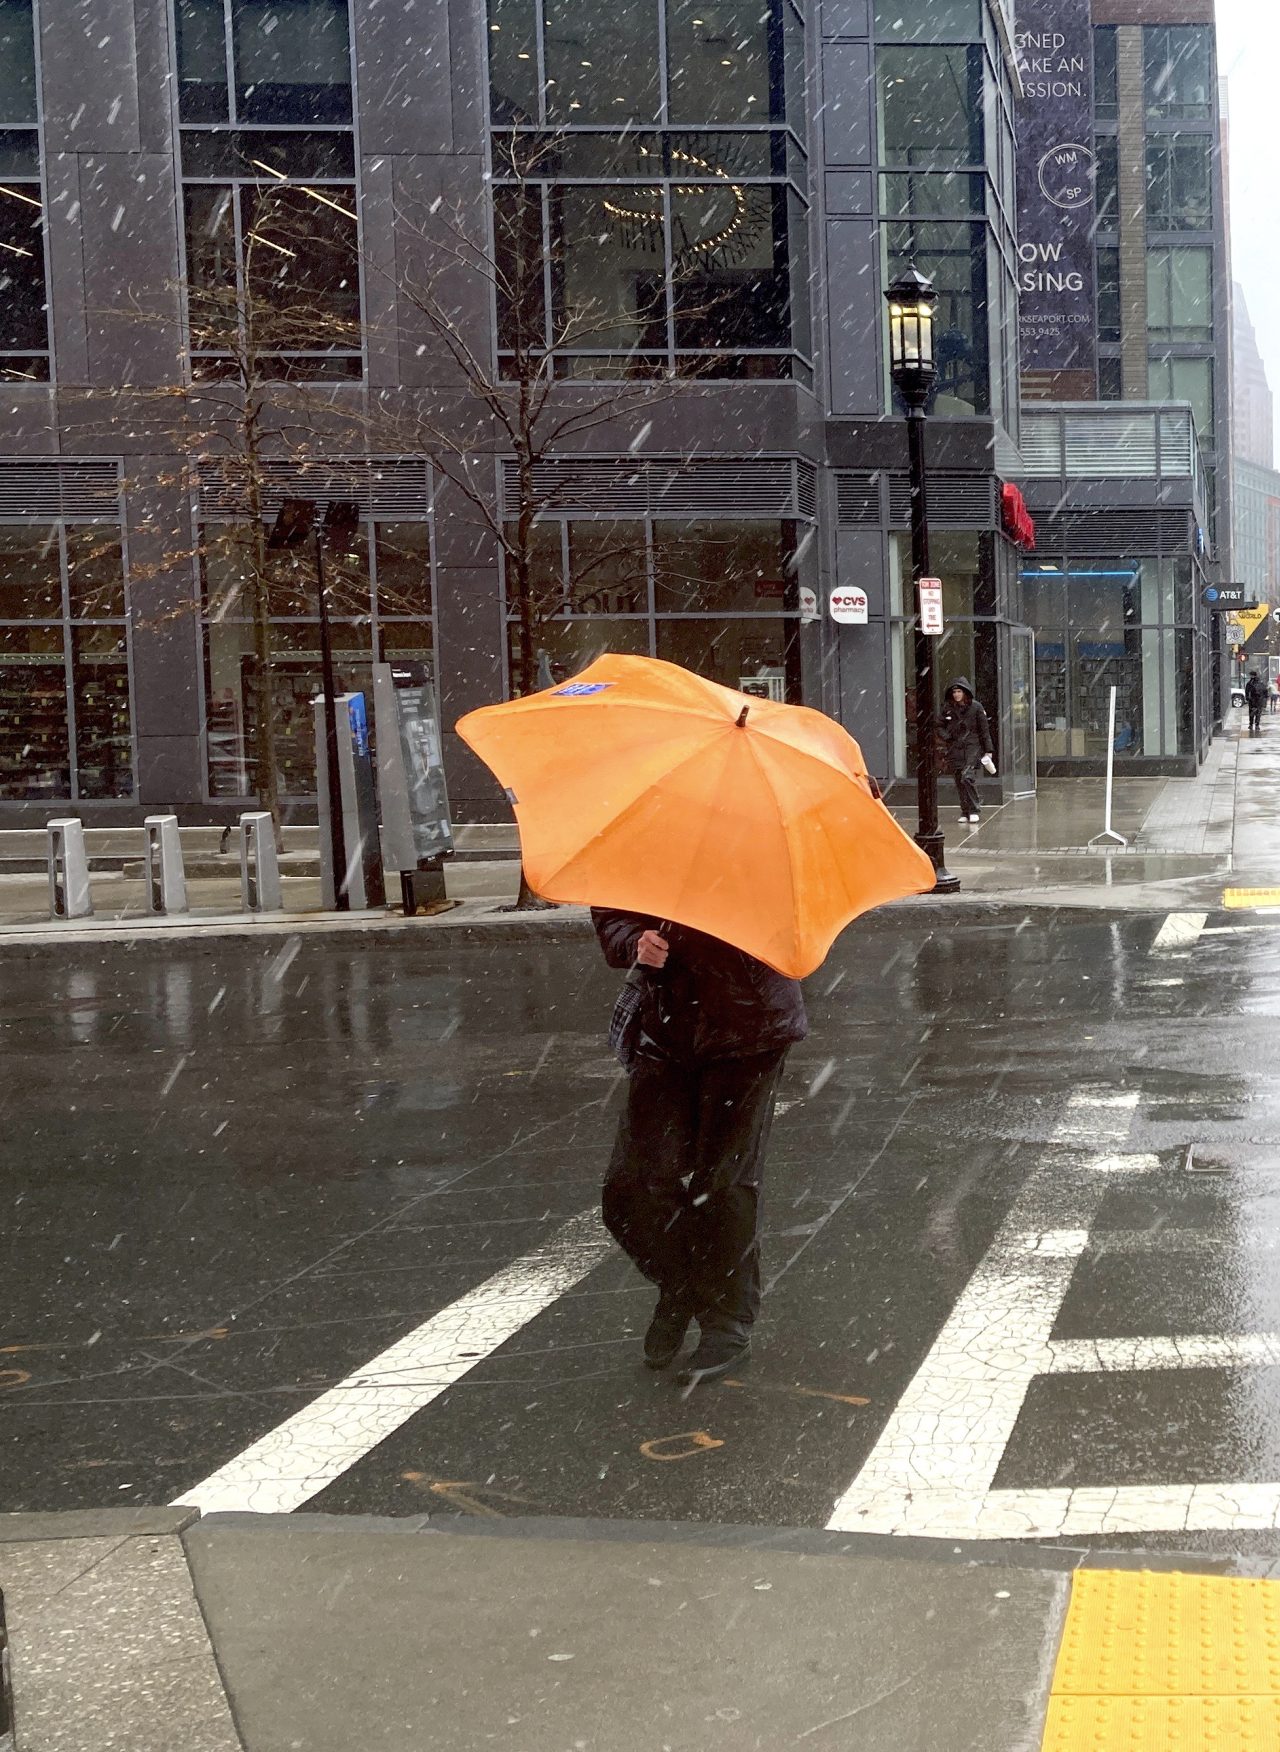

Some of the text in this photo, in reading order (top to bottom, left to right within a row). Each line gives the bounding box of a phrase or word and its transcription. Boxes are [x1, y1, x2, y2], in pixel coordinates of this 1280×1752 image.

[1057, 57, 1084, 72] AN
[1054, 151, 1077, 165] WM
[1066, 187, 1082, 199] SP
[1219, 591, 1242, 599] AT&T
[843, 597, 865, 606] CVS
